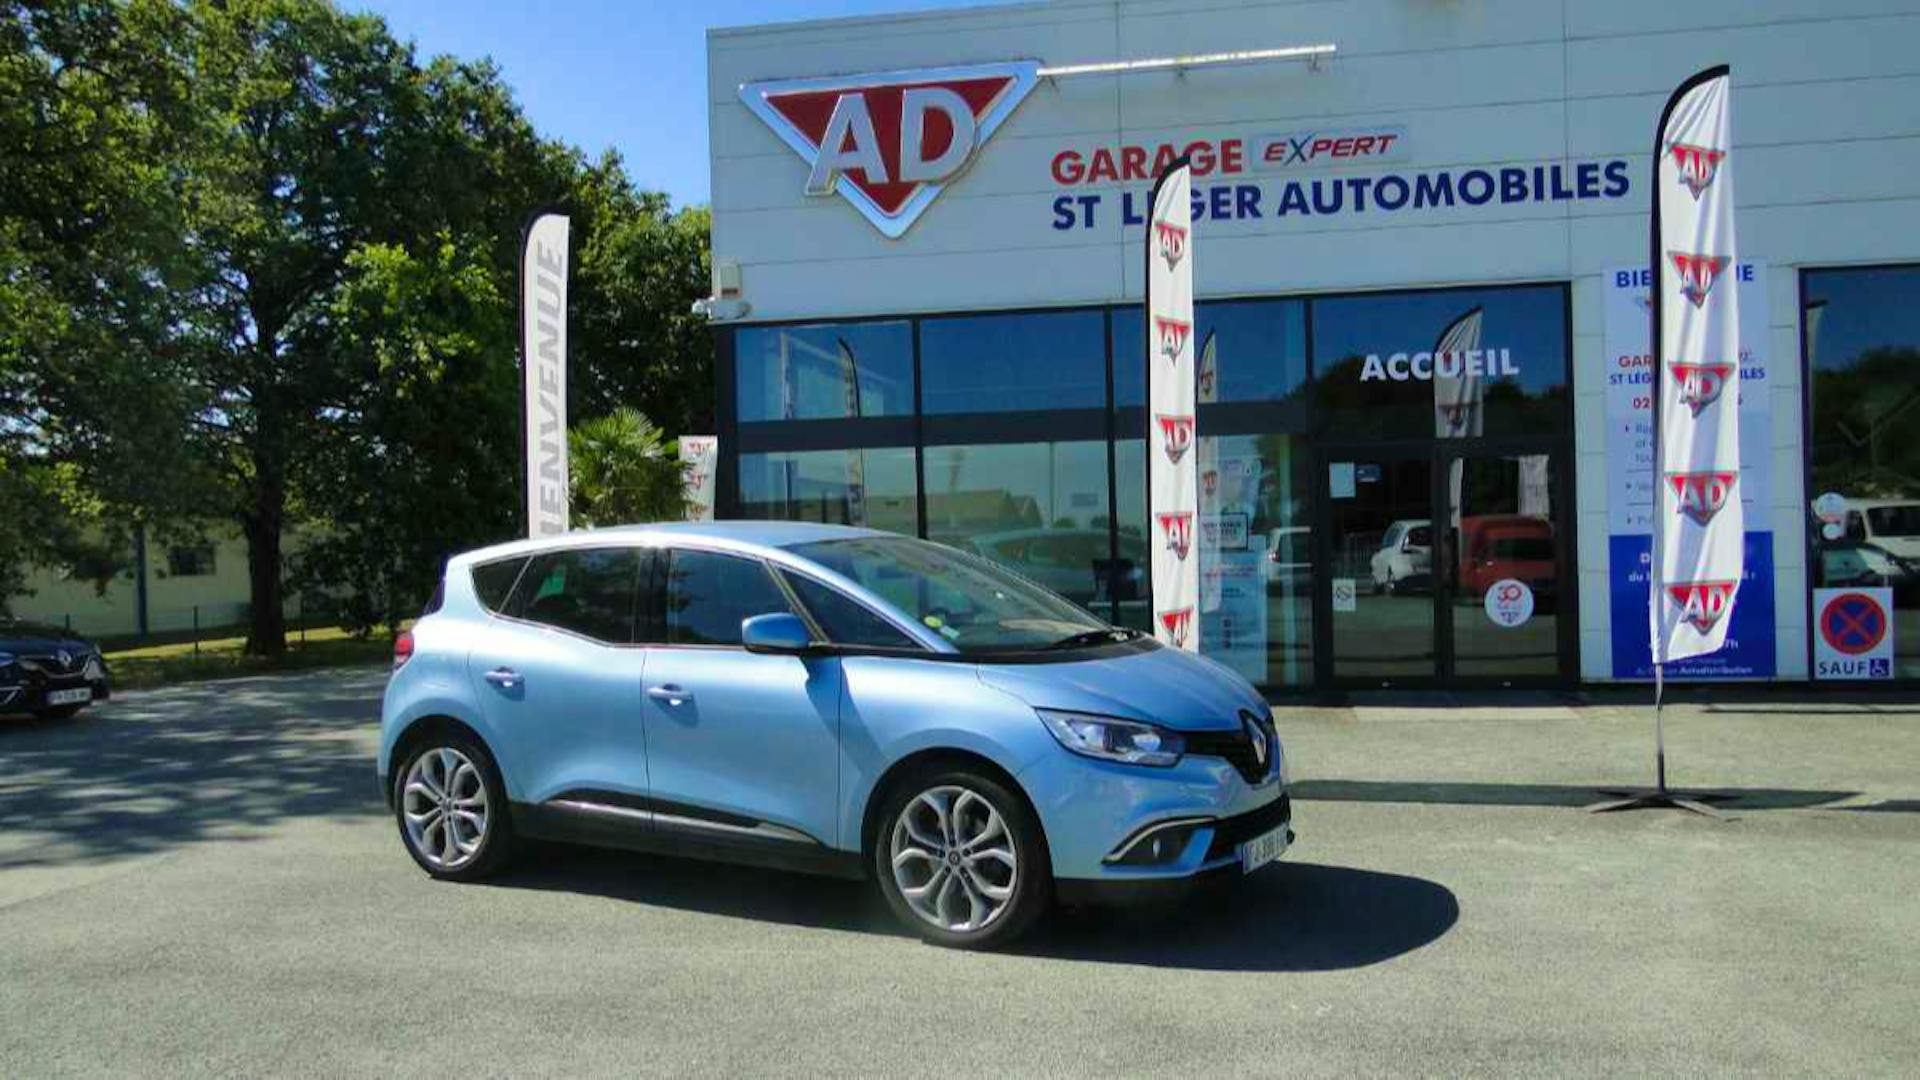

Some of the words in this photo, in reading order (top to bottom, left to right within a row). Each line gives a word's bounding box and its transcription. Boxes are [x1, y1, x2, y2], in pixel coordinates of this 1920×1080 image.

[804, 86, 980, 197] AD
[1051, 138, 1243, 186] GARAGE
[1052, 194, 1102, 231] ST
[1122, 184, 1263, 226] LGER
[1277, 160, 1630, 217] AUTOMOBILES
[1160, 229, 1184, 258] AD
[1359, 348, 1520, 382] ACCUEIL
[536, 238, 563, 536] IENVENUE
[1679, 370, 1725, 404] AD
[1165, 420, 1191, 451] AD
[1677, 478, 1728, 514] AD
[1681, 586, 1727, 623] AD
[1818, 661, 1867, 676] SAUF
